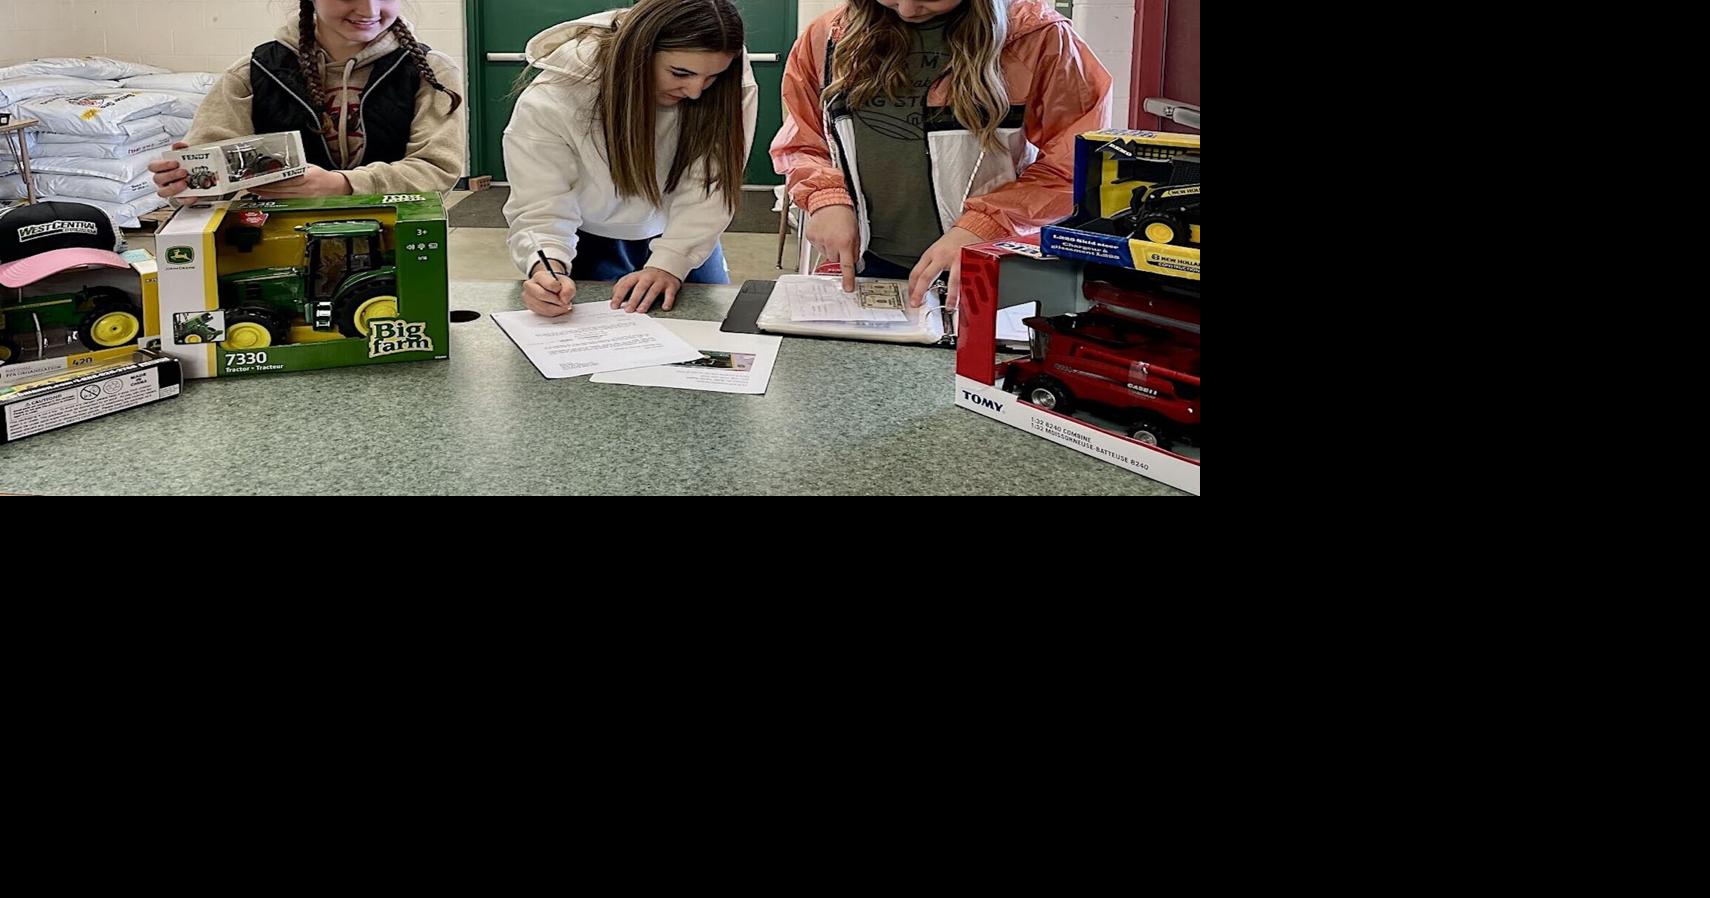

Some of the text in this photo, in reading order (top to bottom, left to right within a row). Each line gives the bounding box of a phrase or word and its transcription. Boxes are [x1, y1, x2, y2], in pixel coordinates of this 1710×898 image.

[182, 153, 210, 161] FENDT
[283, 167, 306, 178] FENDT
[19, 224, 52, 237] WEST
[1177, 259, 1200, 267] HOLLA
[374, 322, 422, 341] Big
[373, 339, 430, 354] farm
[72, 356, 93, 366] 420
[225, 352, 267, 366] 7330
[962, 390, 1003, 412] TOMY
[1030, 416, 1092, 443] 1:32 8240 COMBINE
[1030, 422, 1044, 432] 1:32
[1130, 459, 1150, 471] 8240
